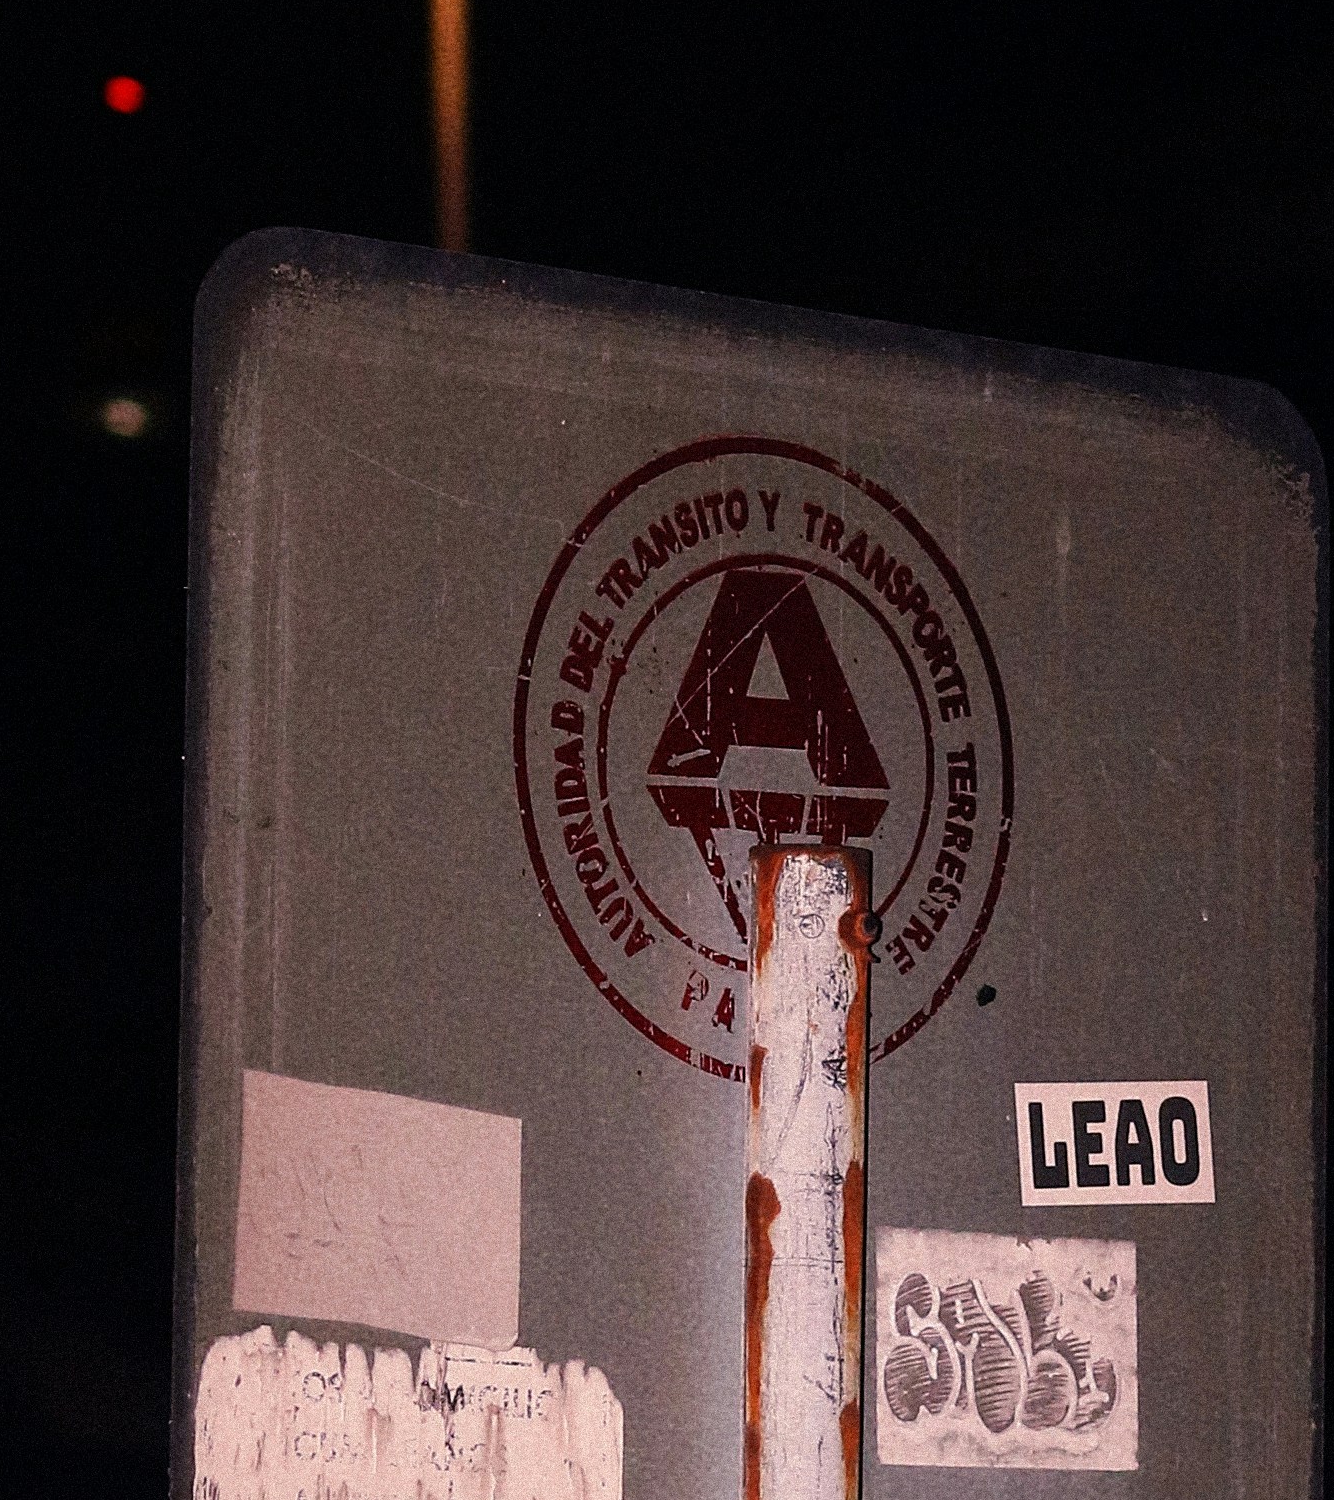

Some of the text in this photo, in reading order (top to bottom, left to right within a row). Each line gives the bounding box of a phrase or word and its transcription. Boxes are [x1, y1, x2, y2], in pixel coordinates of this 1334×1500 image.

[551, 487, 978, 976] AUTORIDAD DEL TRANSITO Y TRANSPORTE TERRESTRE
[1027, 1096, 1201, 1190] LEAO
